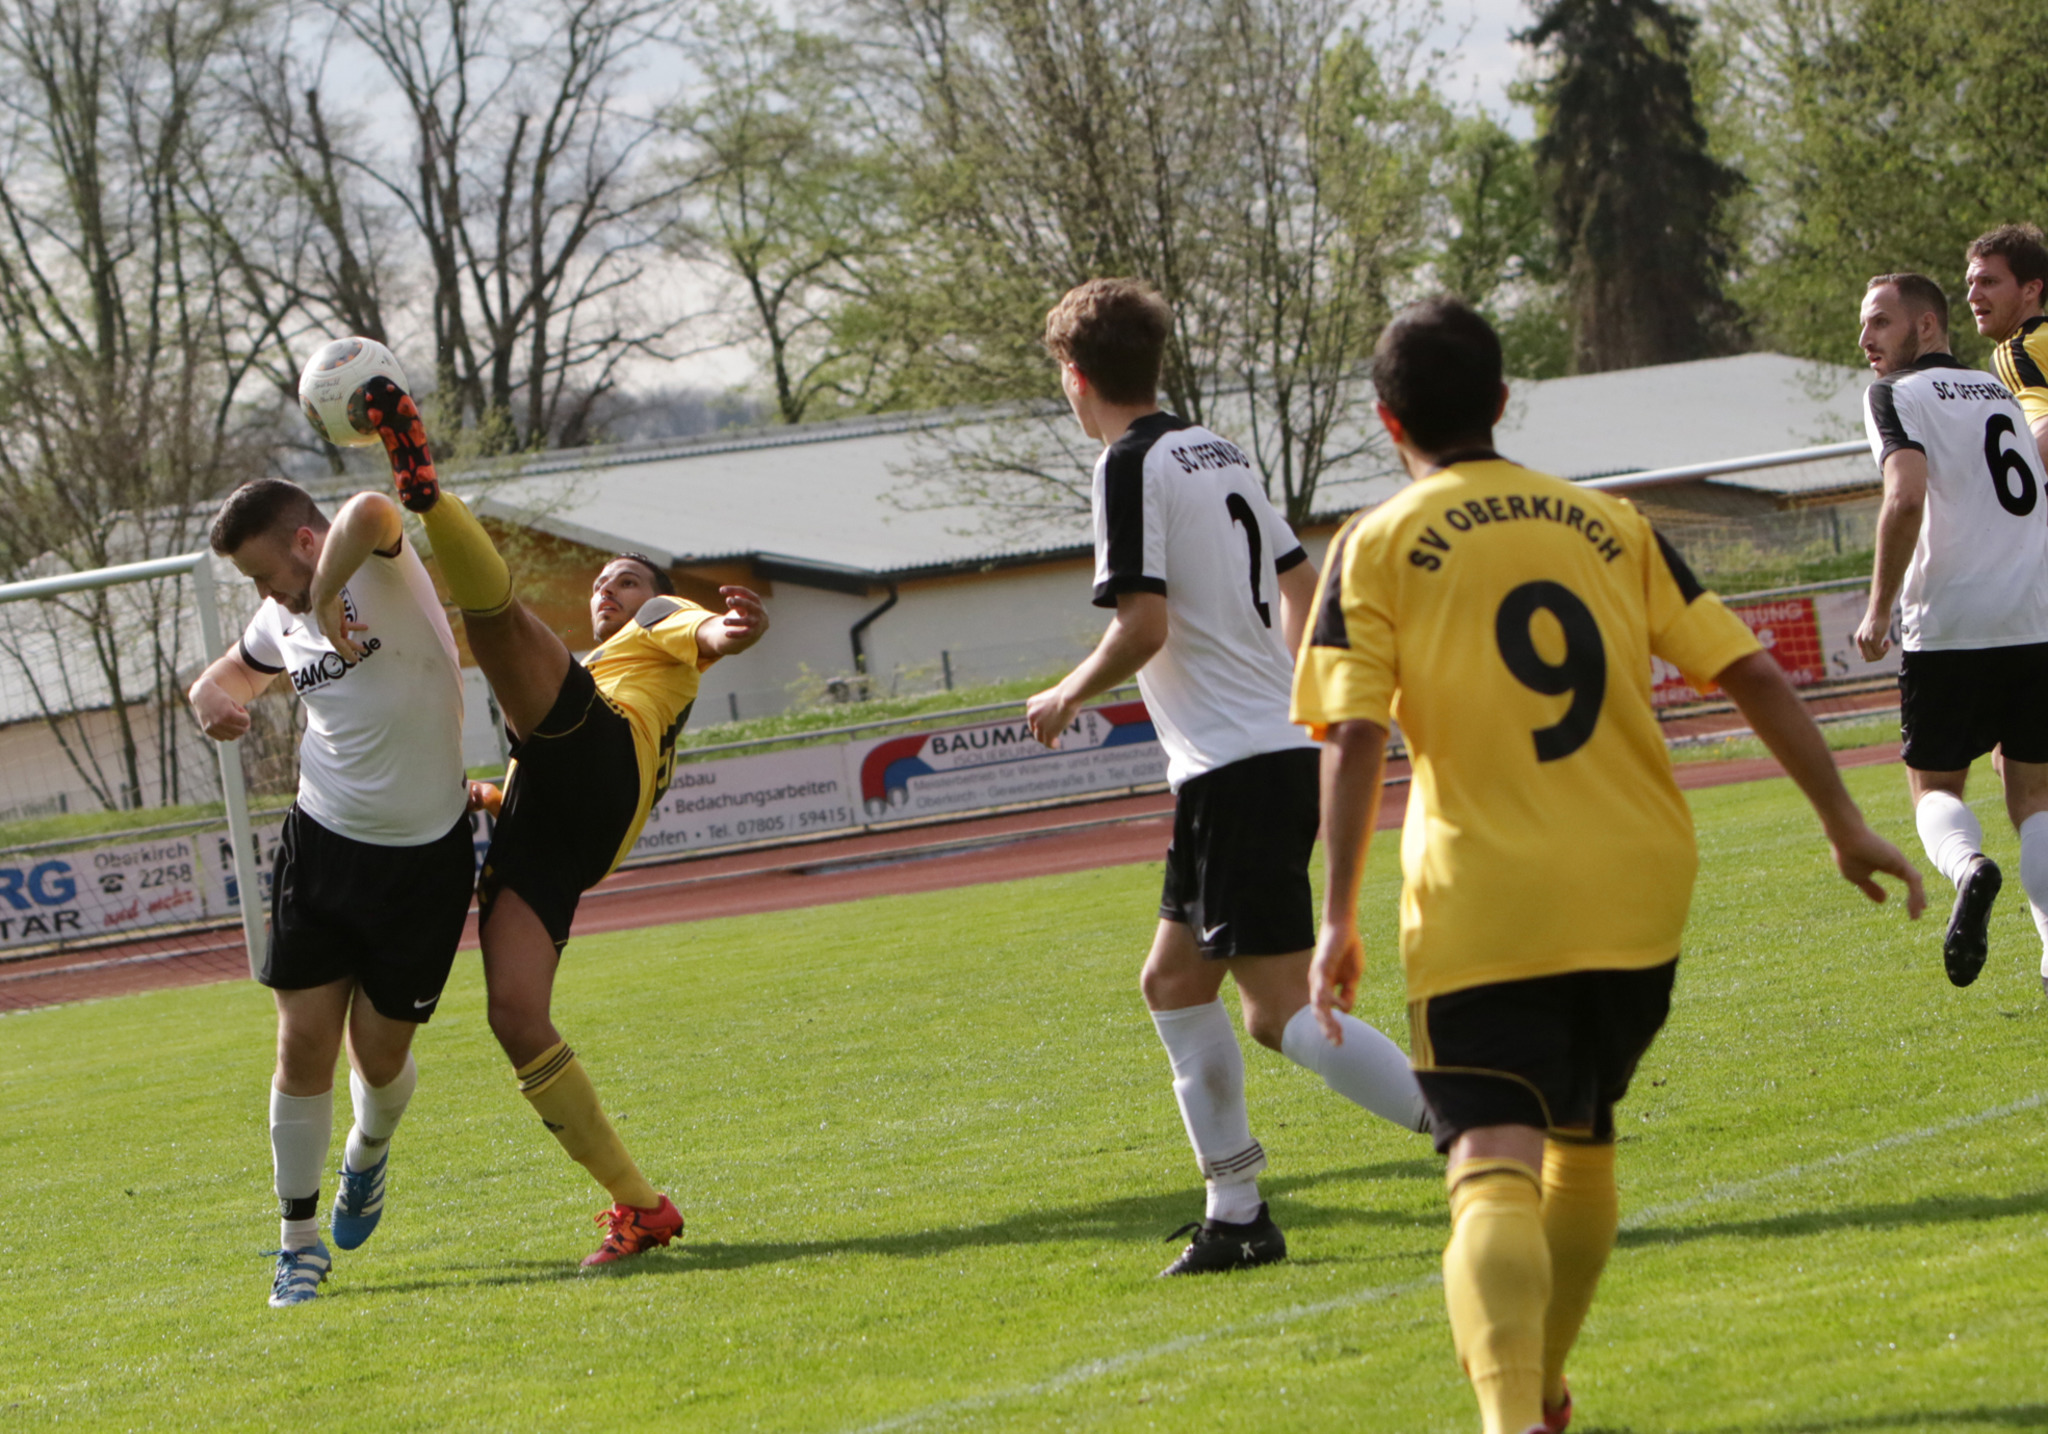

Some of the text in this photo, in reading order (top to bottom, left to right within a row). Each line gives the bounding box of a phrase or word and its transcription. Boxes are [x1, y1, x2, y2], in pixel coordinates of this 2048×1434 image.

[1932, 381, 2015, 402] SC OFFENB
[1171, 446, 1199, 474] SC
[1985, 413, 2037, 517] 6
[1409, 495, 1623, 572] SV OBERKIRCH
[1496, 580, 1607, 764] 9
[931, 717, 1082, 755] BAUMAN
[675, 780, 838, 814] Bedachungsarbeiten
[708, 823, 731, 839] Tel.
[737, 815, 784, 836] 07805
[799, 807, 847, 827] 59415
[94, 841, 189, 870] Oberkirch
[0, 860, 77, 911] RG
[139, 863, 192, 889] 2258
